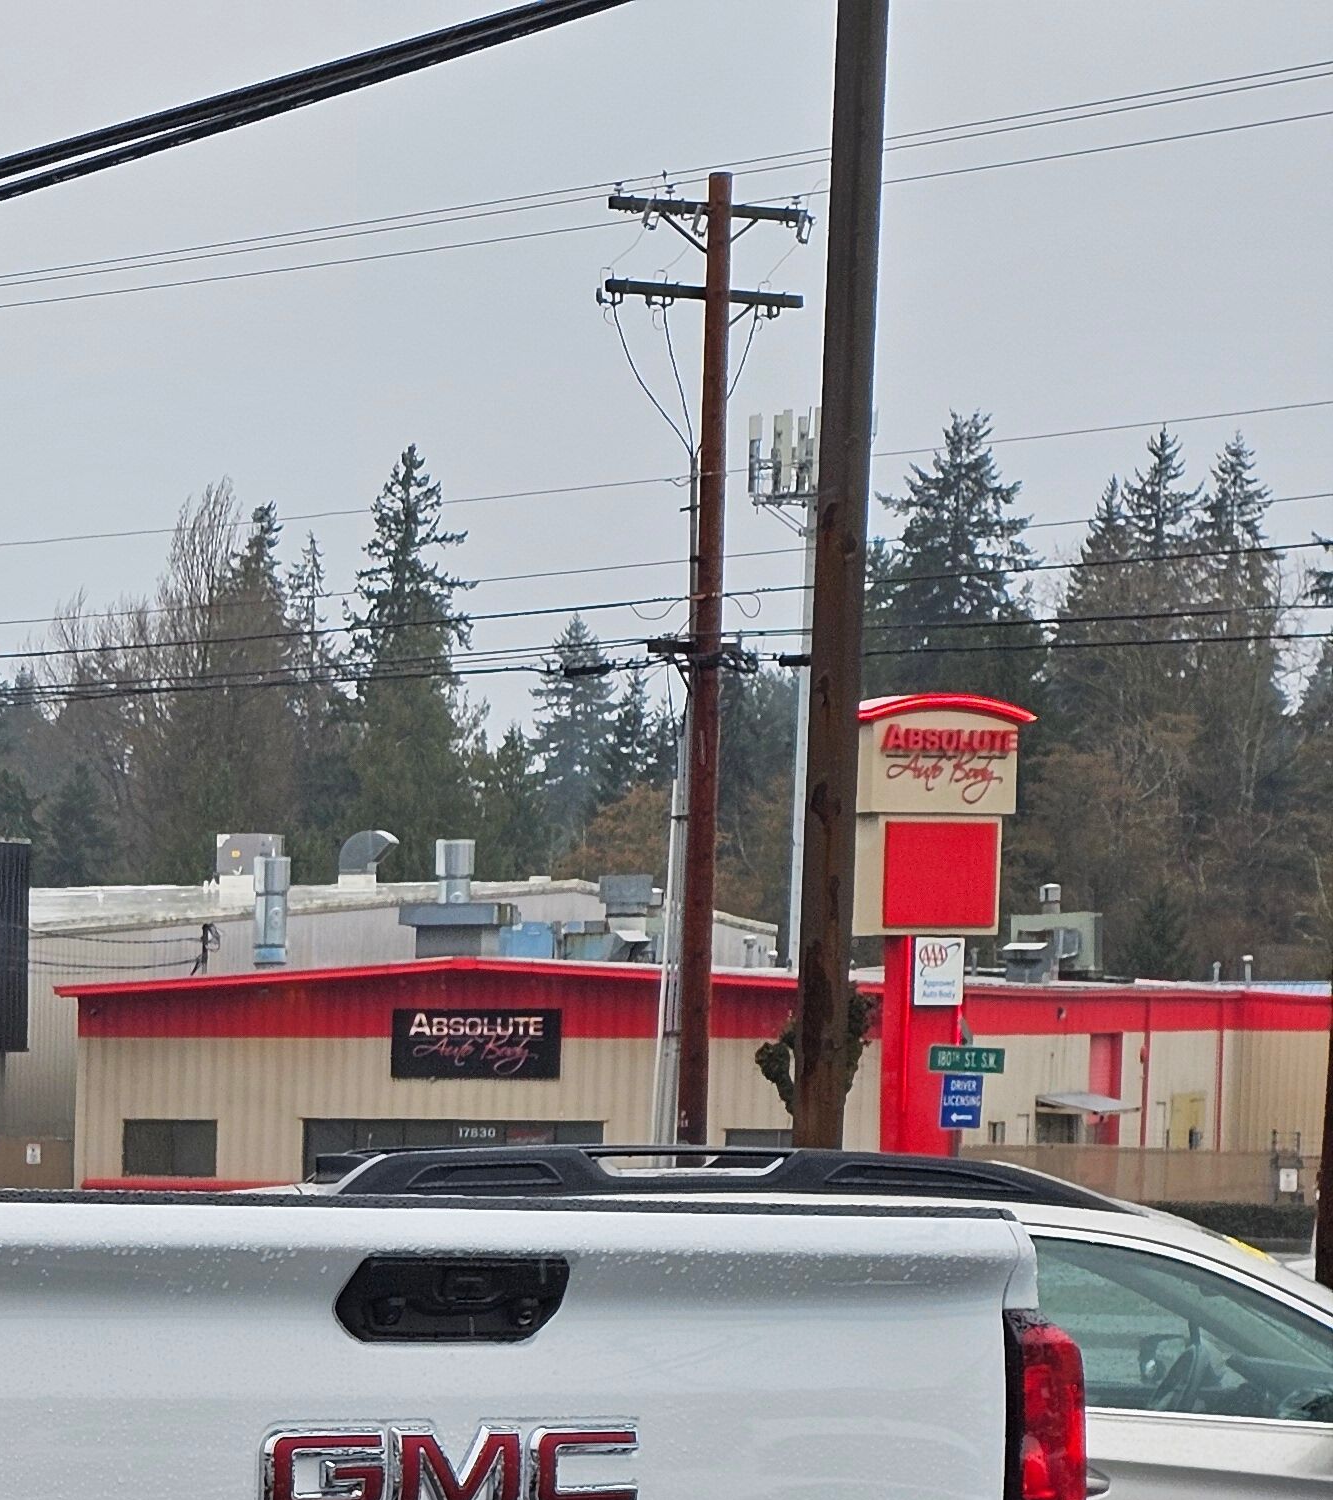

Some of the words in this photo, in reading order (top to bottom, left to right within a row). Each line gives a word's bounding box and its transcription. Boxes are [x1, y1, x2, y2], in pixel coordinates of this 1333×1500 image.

[882, 724, 1018, 752] ABSOLUTE
[949, 752, 1003, 804] Body
[409, 1012, 545, 1037] ABSOLUTE
[950, 1079, 977, 1091] DRIVER
[943, 1095, 981, 1107] LICENSING
